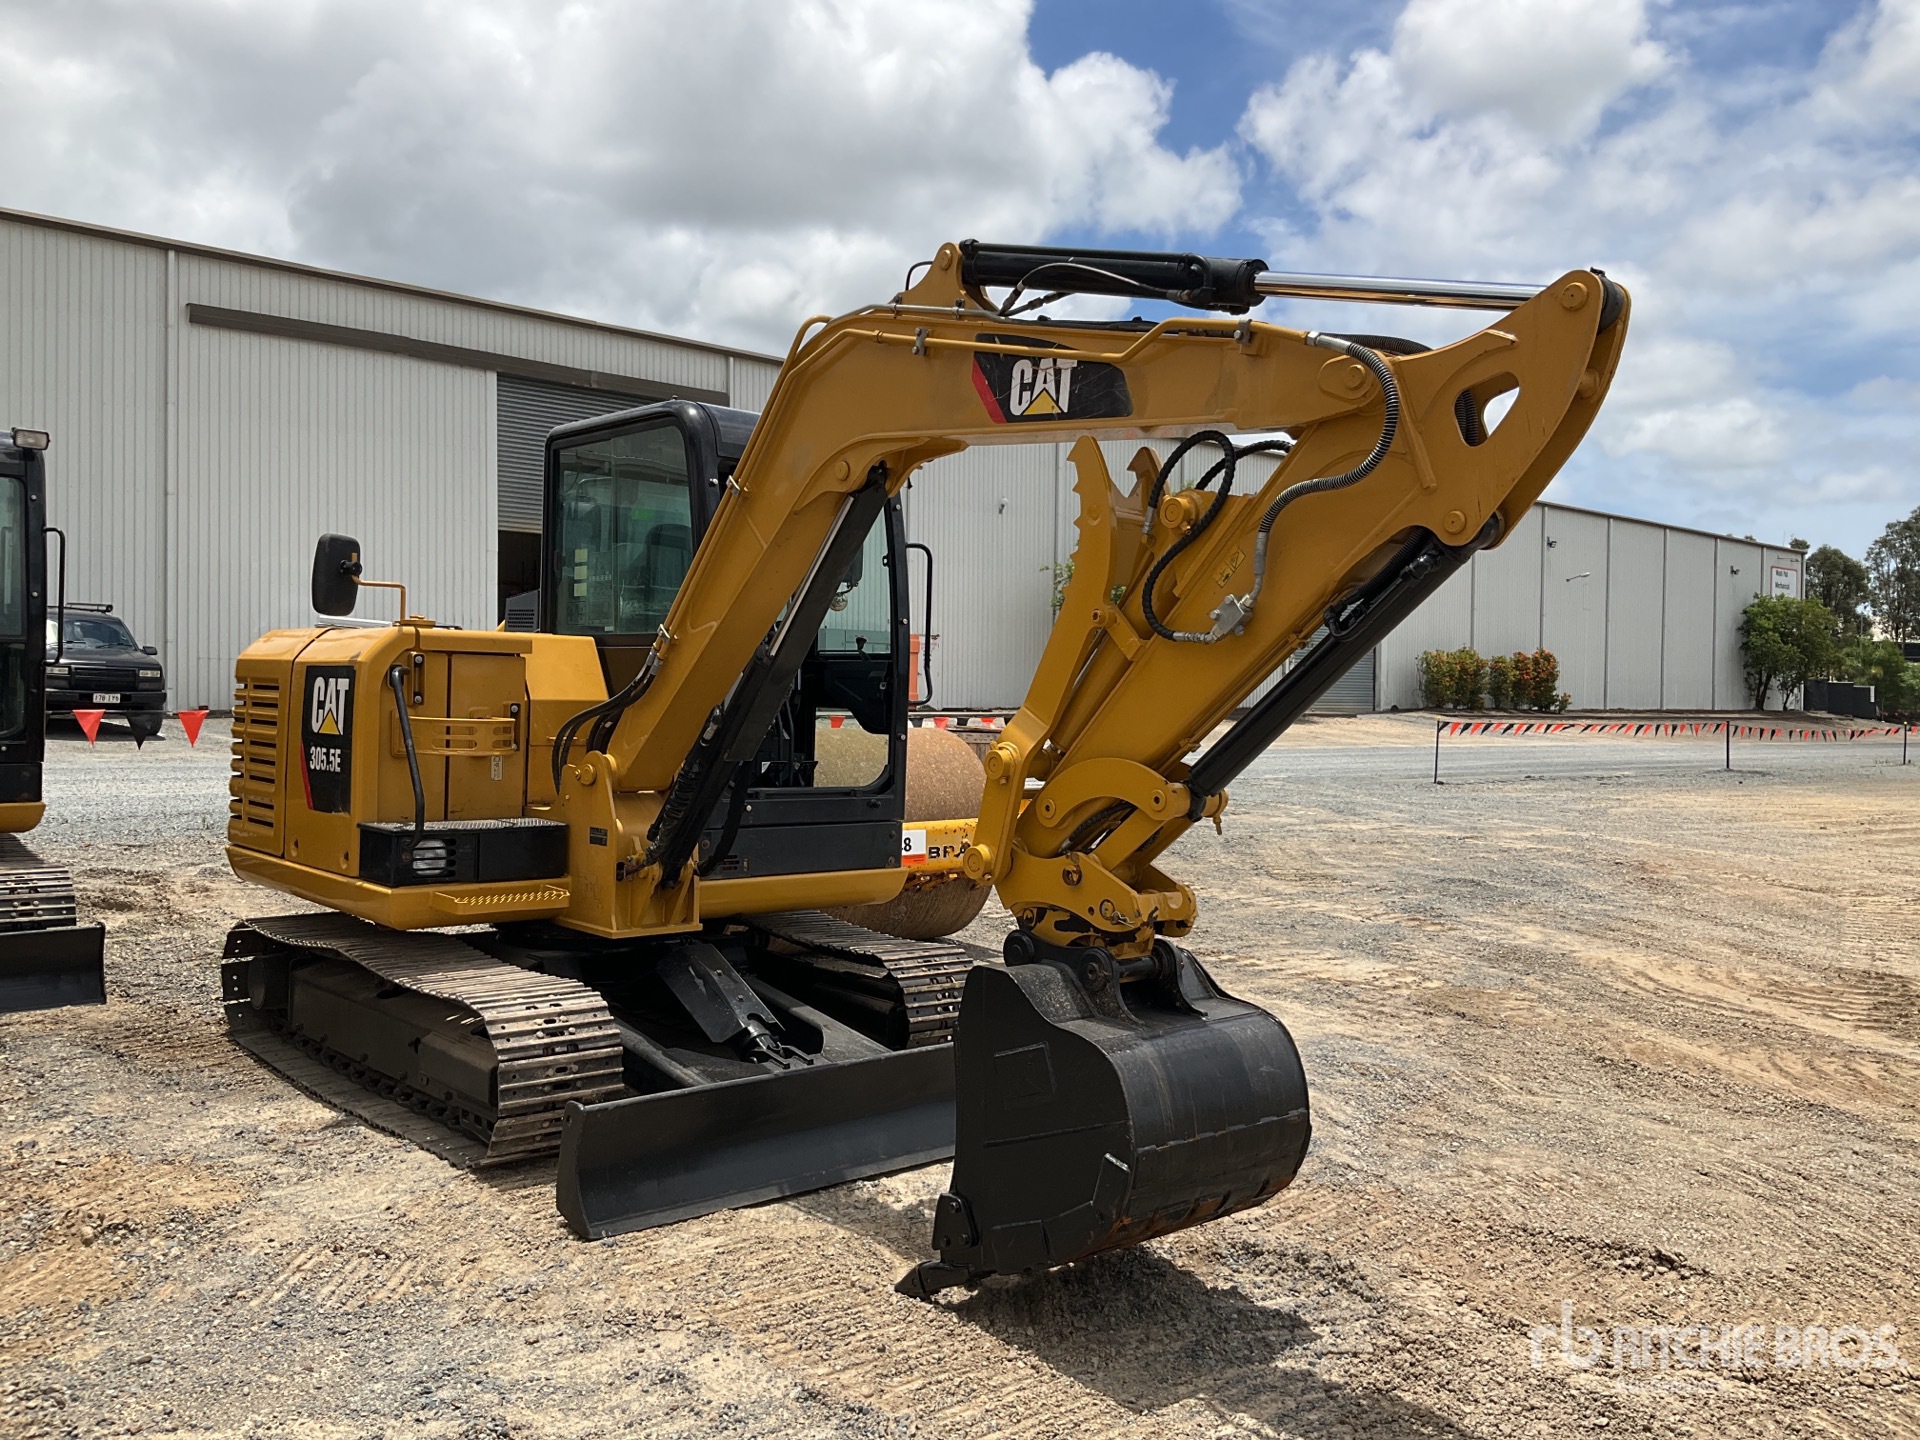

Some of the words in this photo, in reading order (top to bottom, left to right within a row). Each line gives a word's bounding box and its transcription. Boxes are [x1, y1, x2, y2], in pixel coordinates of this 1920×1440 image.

[1010, 358, 1077, 415] CAT
[312, 677, 349, 735] CAT
[309, 746, 342, 773] 305.5E
